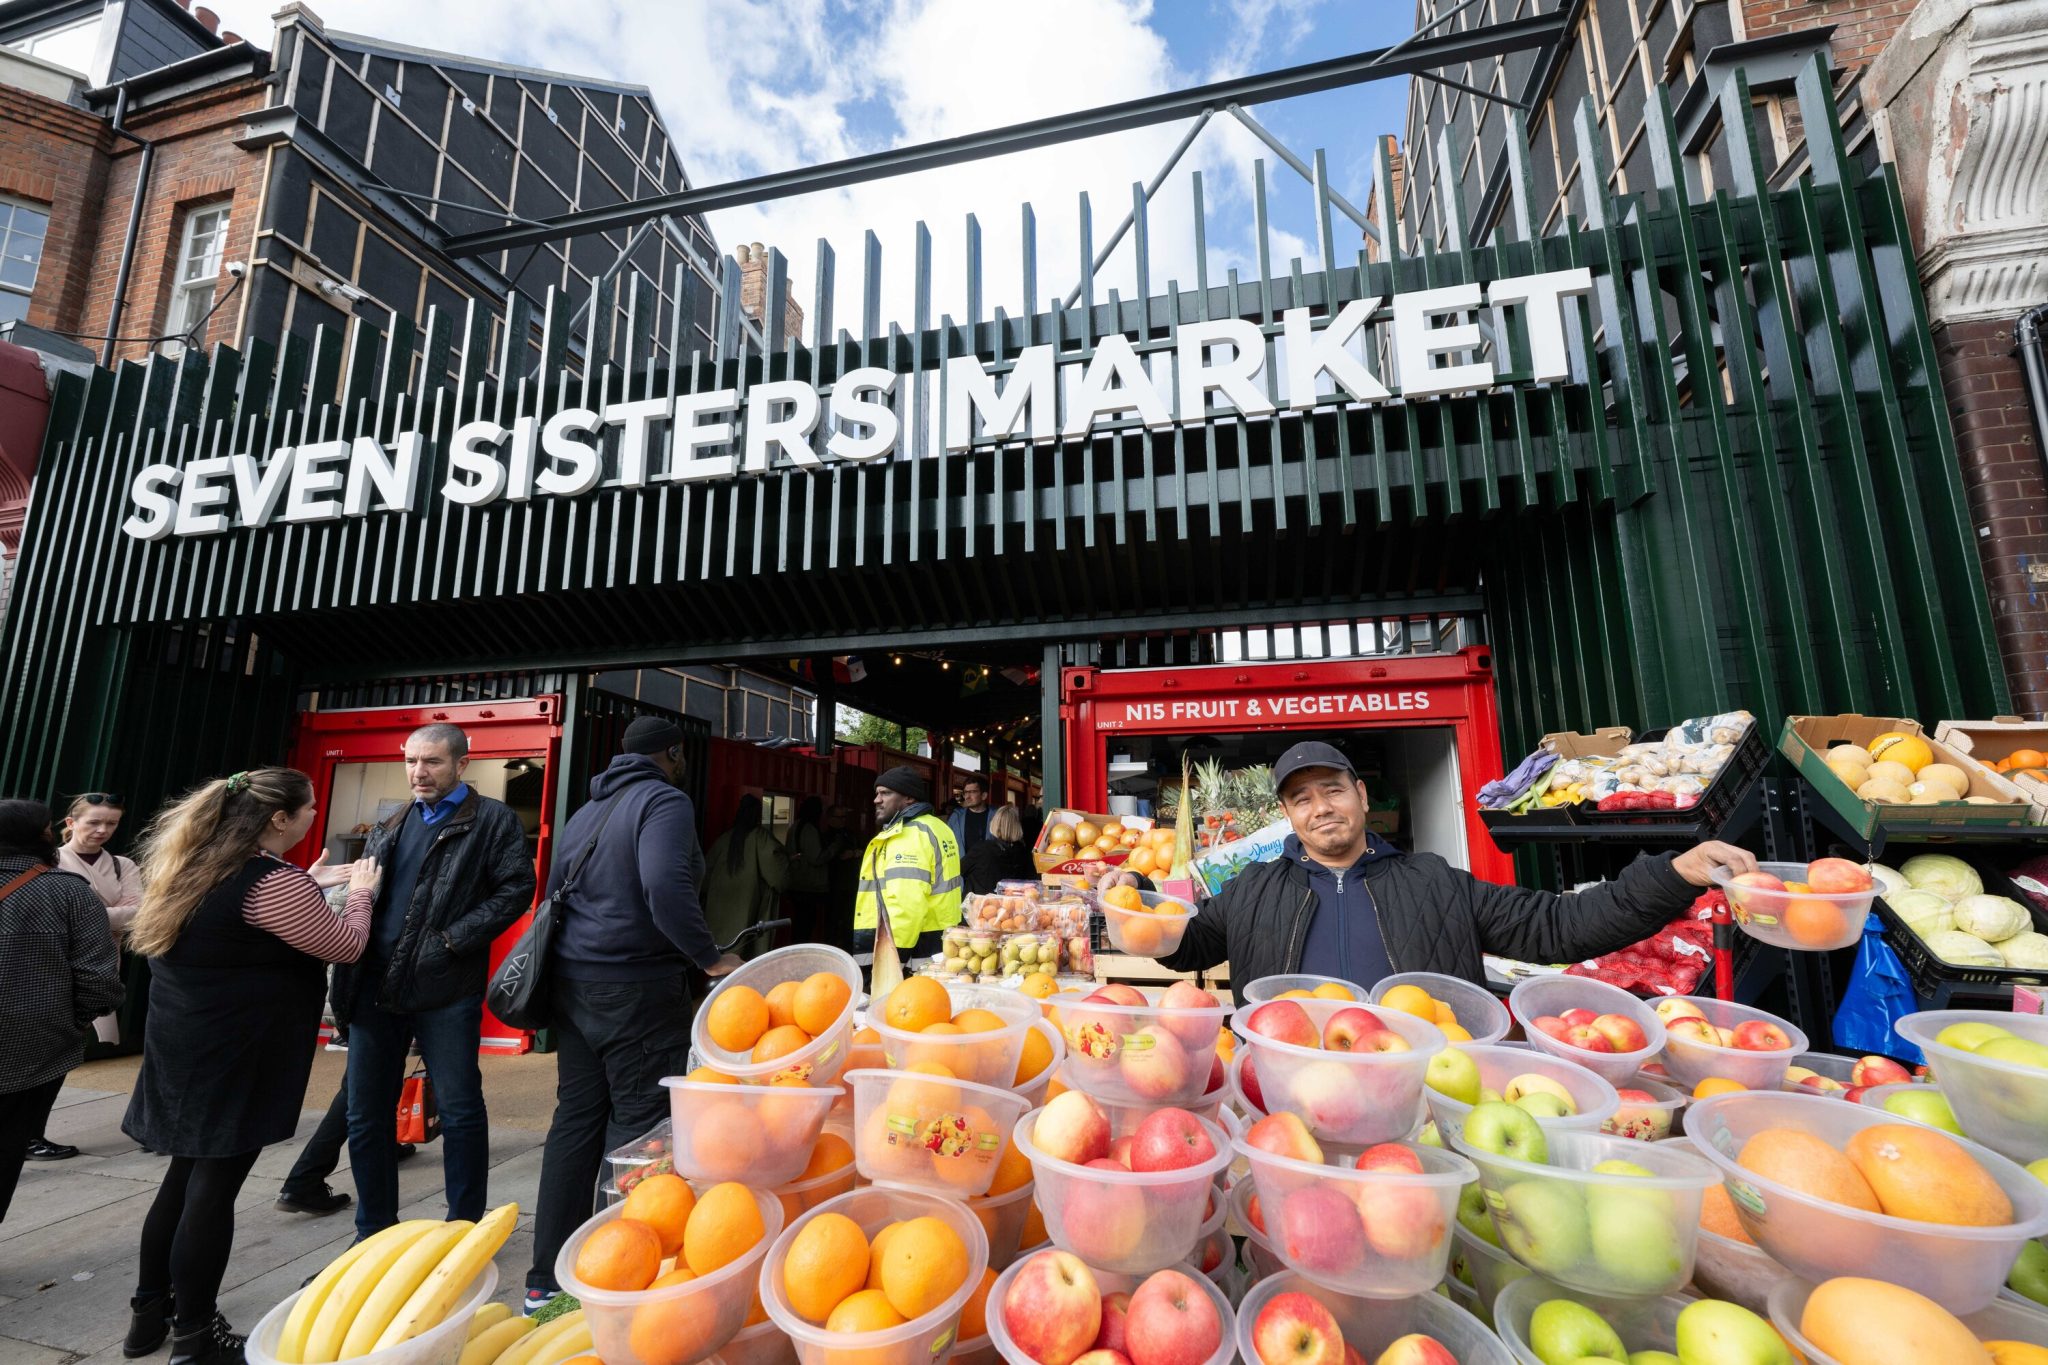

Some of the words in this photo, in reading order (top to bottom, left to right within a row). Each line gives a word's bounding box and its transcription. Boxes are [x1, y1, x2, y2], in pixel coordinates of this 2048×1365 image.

[122, 430, 424, 541] SEVEN
[440, 367, 900, 507] SISTERS
[946, 266, 1593, 453] MARKET
[1126, 702, 1165, 721] N15
[1171, 700, 1239, 719] FRUIT
[1246, 698, 1262, 716] &
[1267, 691, 1430, 715] VEGETABLES
[1118, 720, 1124, 728] 2
[1248, 838, 1284, 861] Young
